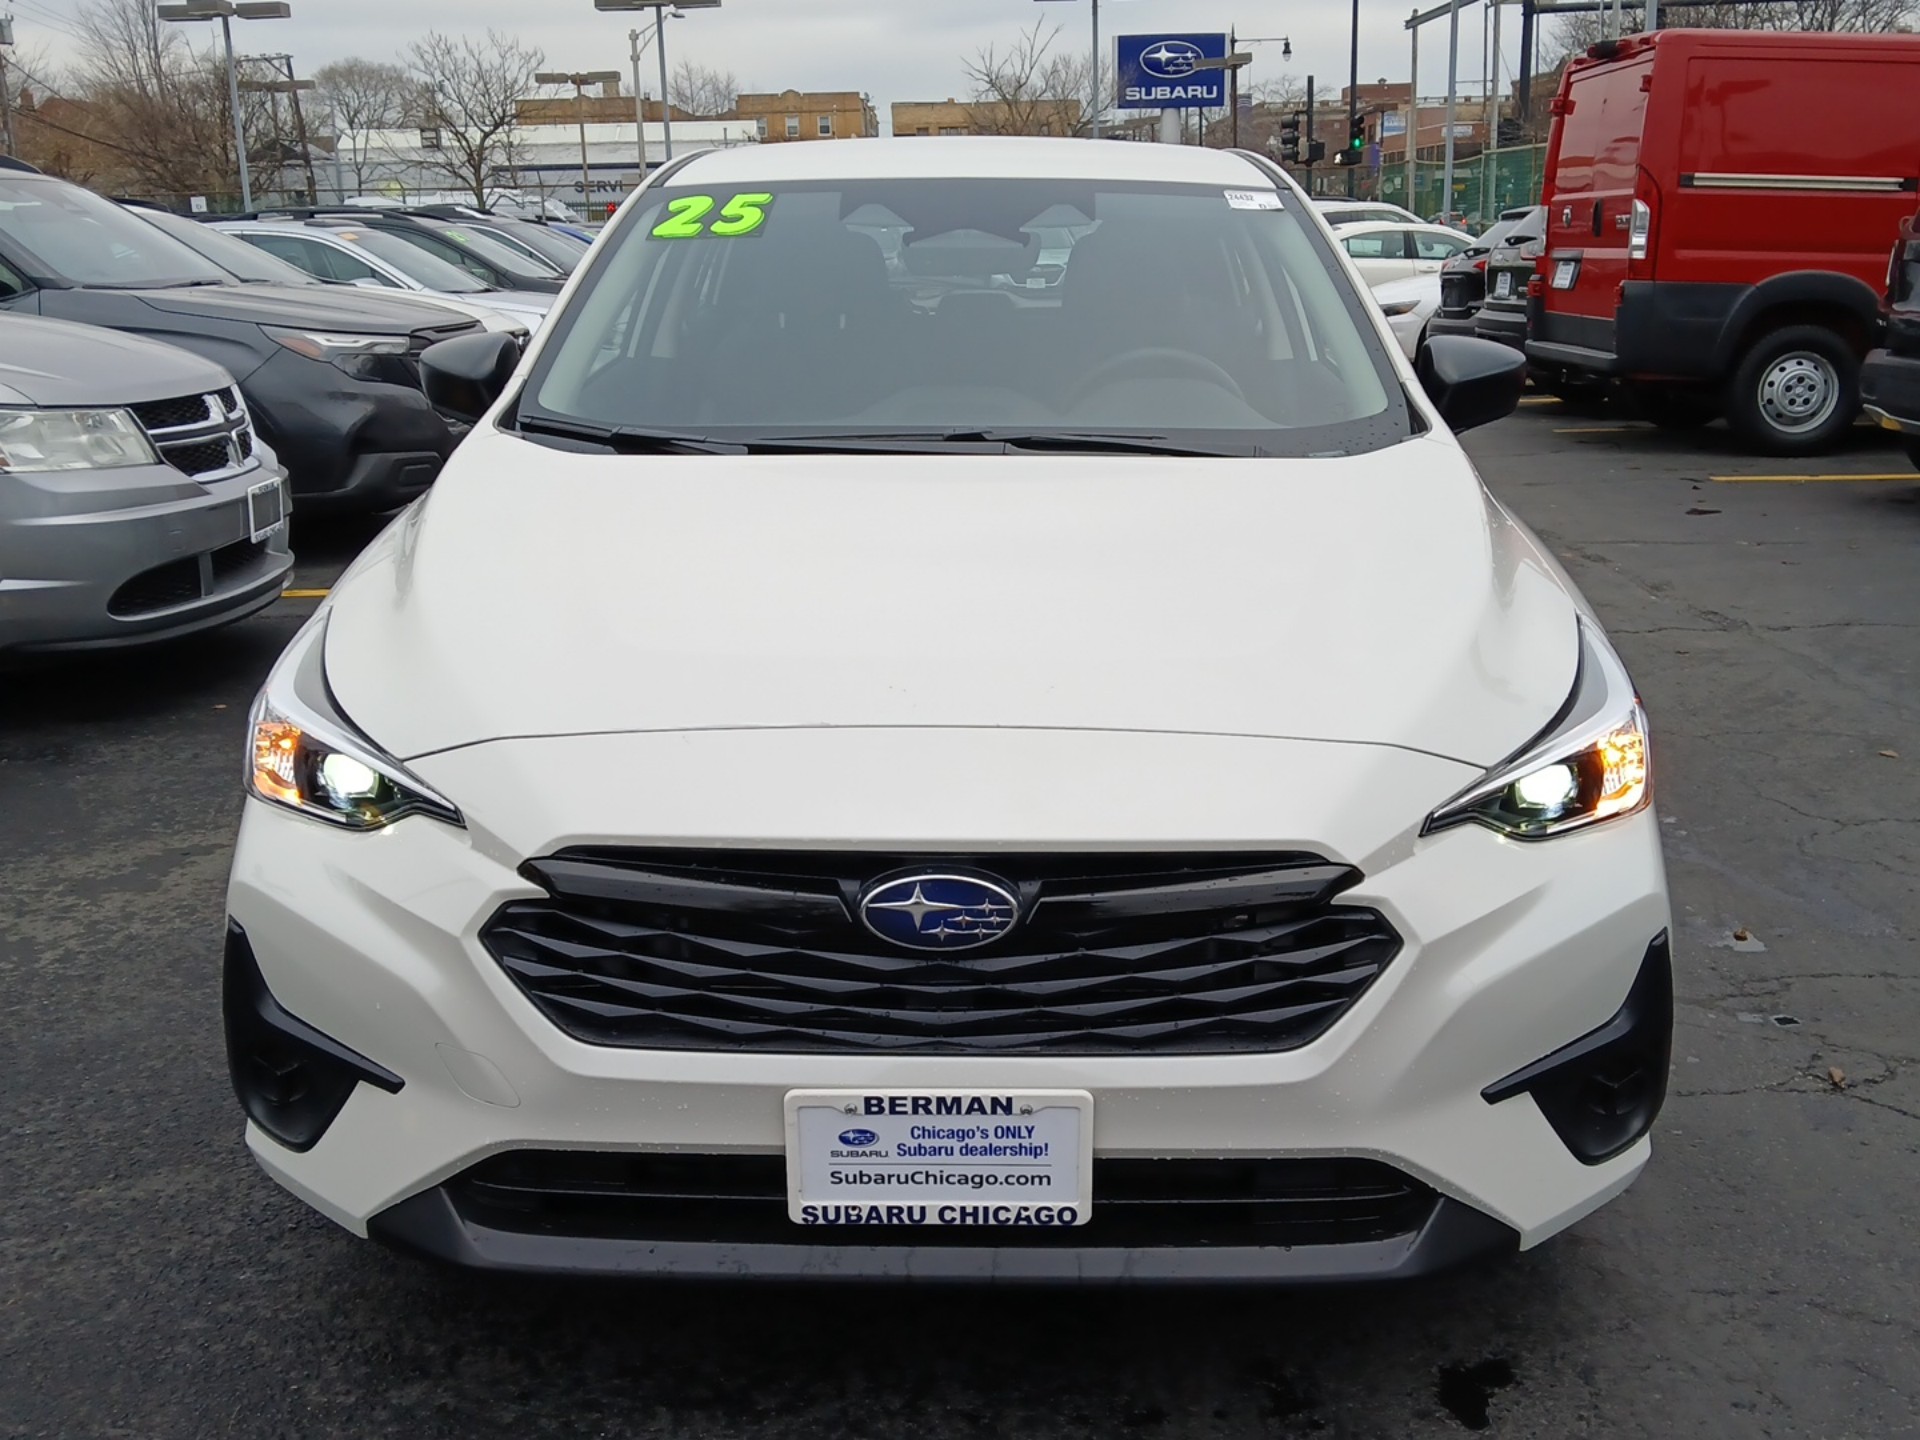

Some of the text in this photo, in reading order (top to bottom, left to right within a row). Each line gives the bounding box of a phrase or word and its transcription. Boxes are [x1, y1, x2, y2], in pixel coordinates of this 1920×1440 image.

[1125, 86, 1217, 100] SUBARU
[575, 180, 624, 193] SERVI
[651, 192, 774, 238] 25
[864, 1096, 1013, 1116] BERMAN
[910, 1125, 1035, 1142] Chicago's ONLY
[830, 1150, 888, 1158] SUBARU
[896, 1143, 1049, 1159] Subaru dealership!
[830, 1170, 1051, 1188] SubaruChicago.com
[801, 1205, 1079, 1225] SUBARU CHICAGO
